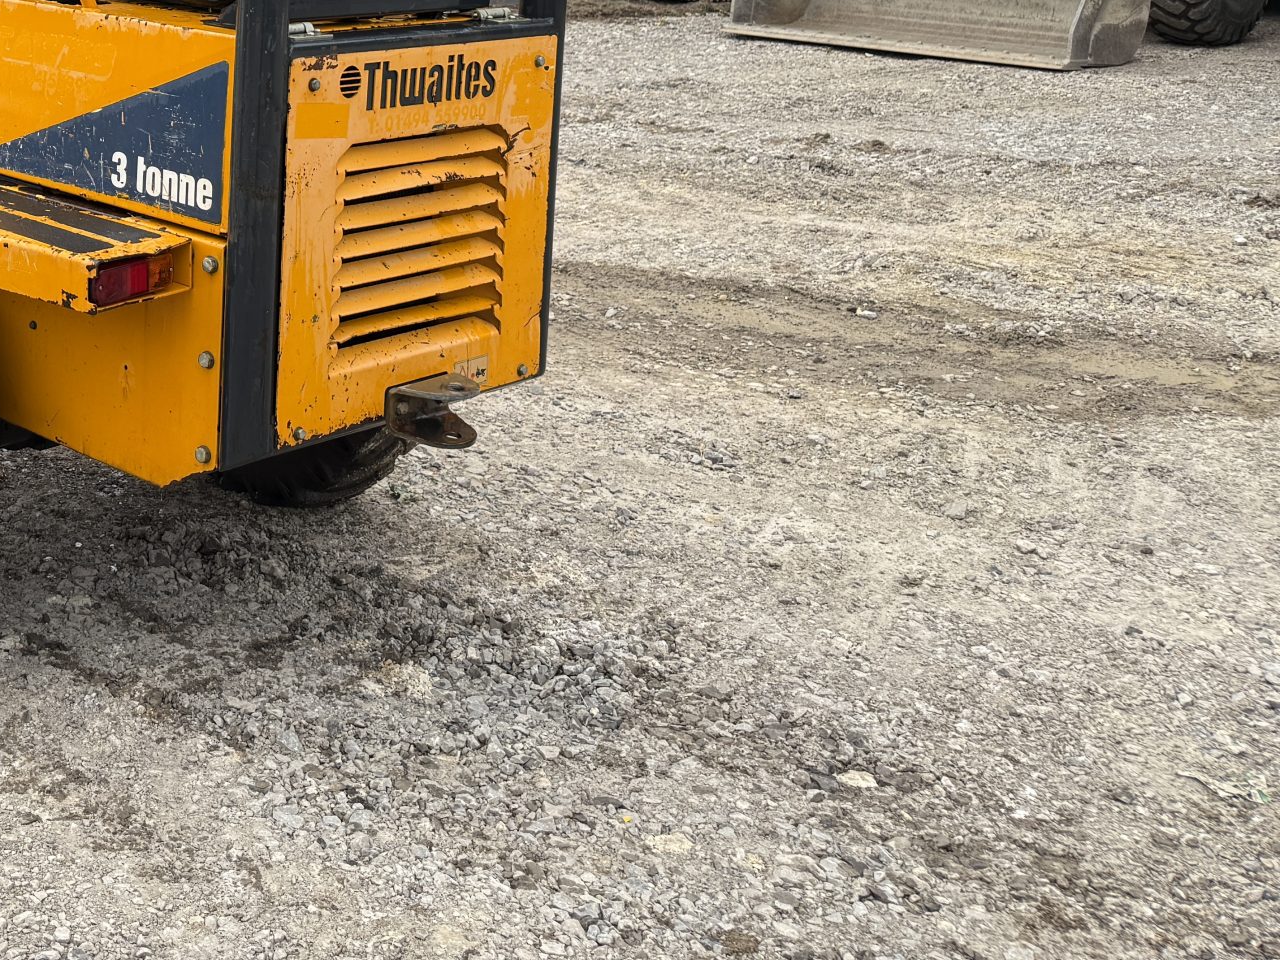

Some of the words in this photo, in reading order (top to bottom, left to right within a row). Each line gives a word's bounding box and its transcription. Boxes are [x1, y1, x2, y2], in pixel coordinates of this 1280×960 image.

[364, 53, 497, 112] Thwaites
[111, 151, 128, 189] 3
[136, 155, 213, 211] tonne
